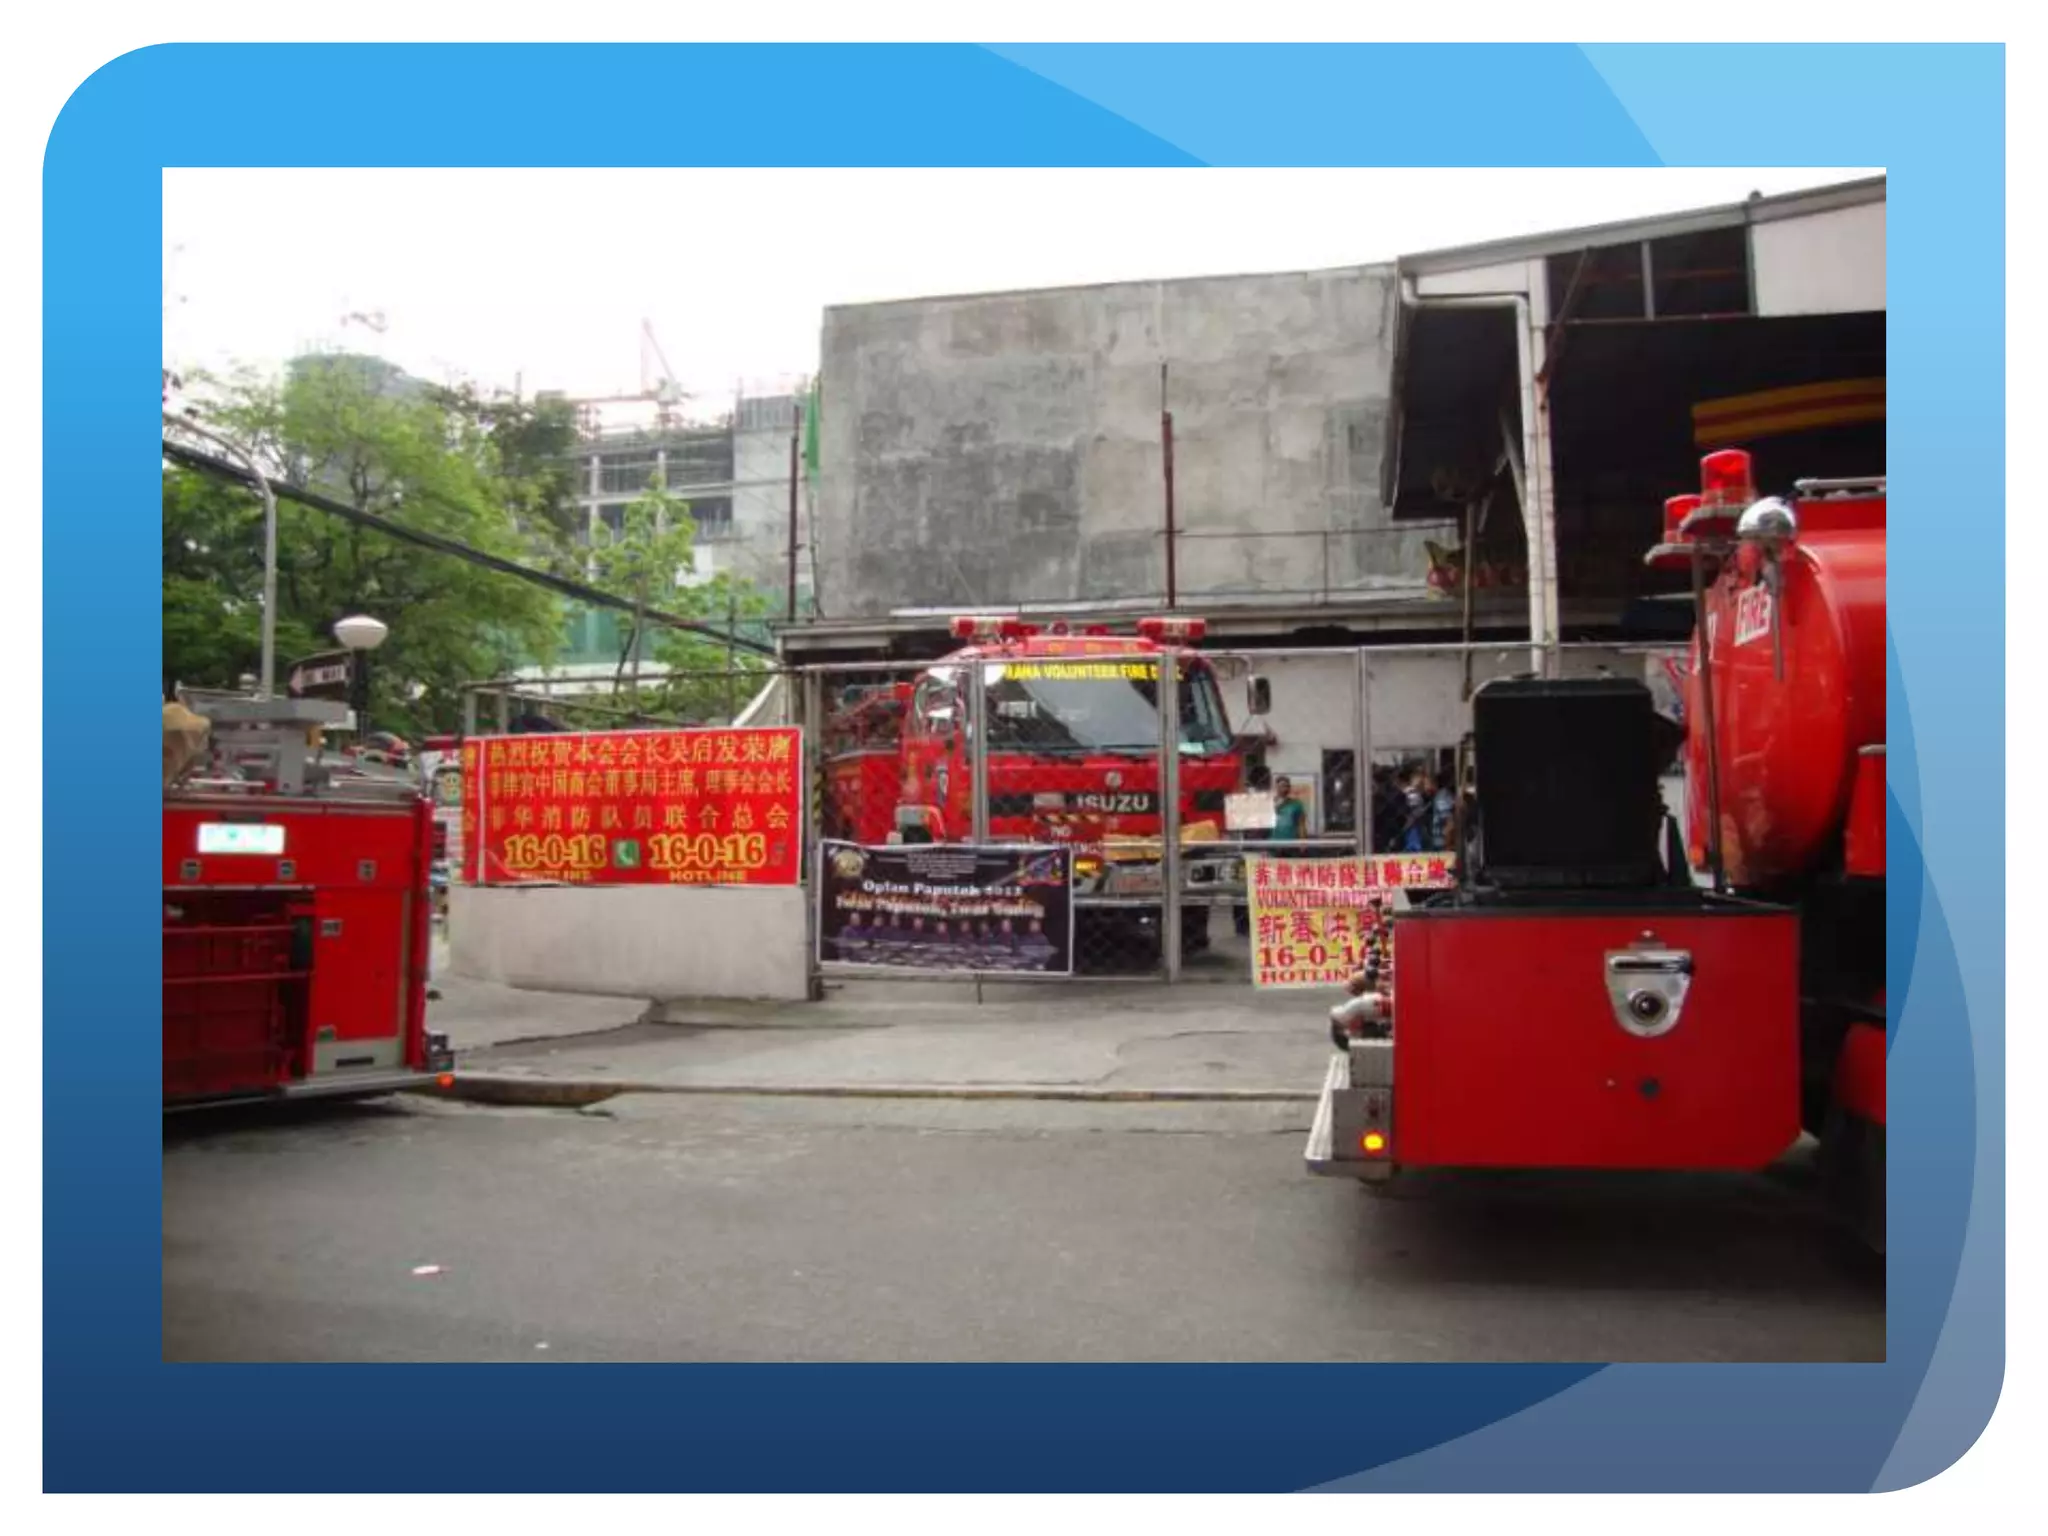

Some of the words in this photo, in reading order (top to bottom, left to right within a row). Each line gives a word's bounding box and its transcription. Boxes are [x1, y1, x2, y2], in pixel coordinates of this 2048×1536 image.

[1076, 793, 1150, 812] ISUZU
[504, 834, 606, 869] 16-0-16
[649, 832, 767, 868] 16-0-16
[1260, 968, 1350, 984] HOTLIN
